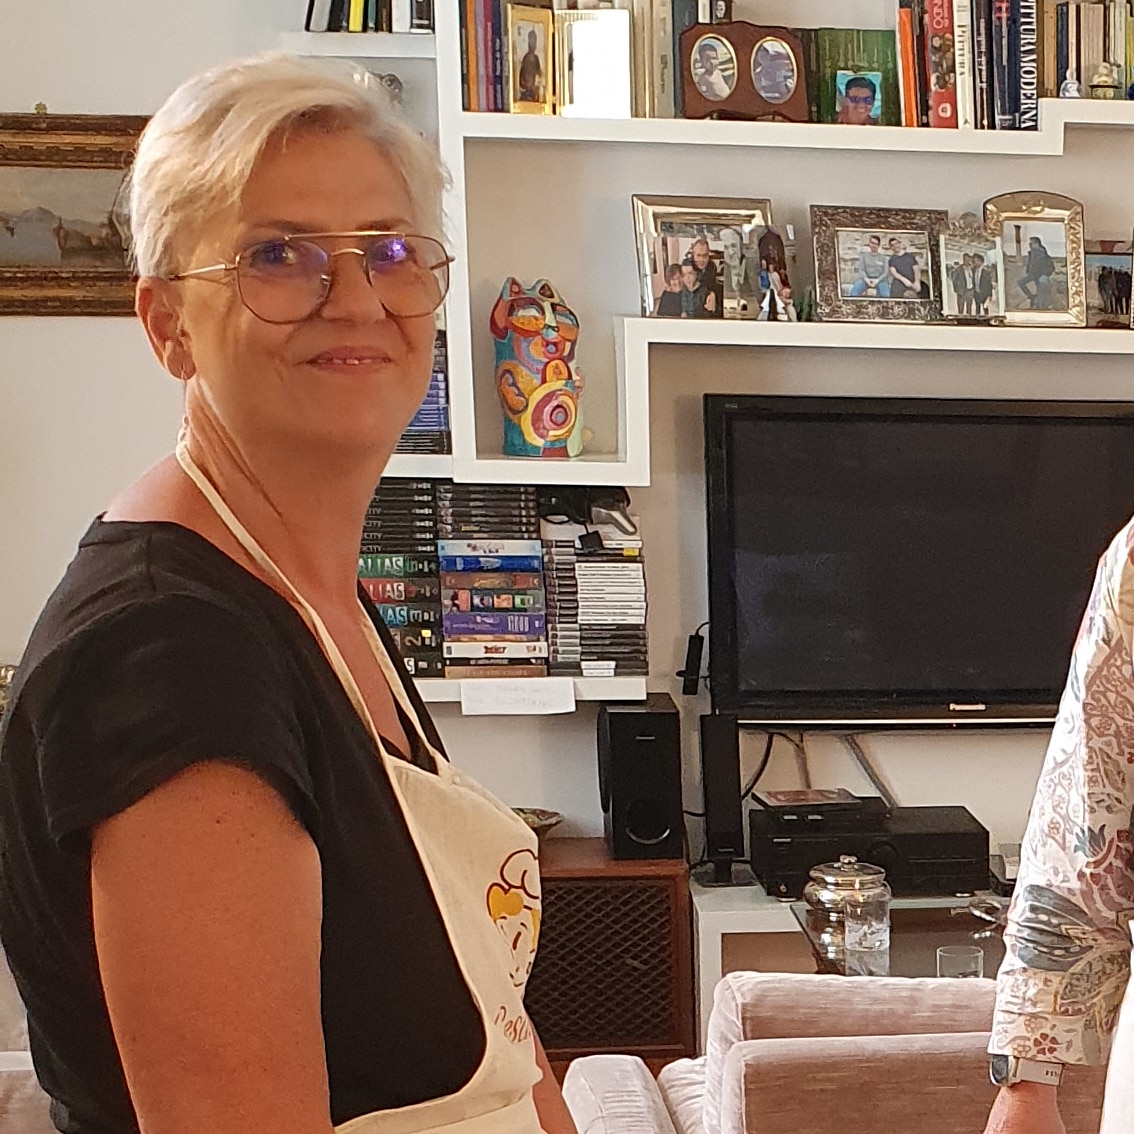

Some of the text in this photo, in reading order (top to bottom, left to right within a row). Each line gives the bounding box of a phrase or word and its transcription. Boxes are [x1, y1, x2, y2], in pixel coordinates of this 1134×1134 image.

[1020, 54, 1037, 128] MODERNA
[359, 557, 404, 572] ALIAS
[369, 583, 405, 600] LIAS
